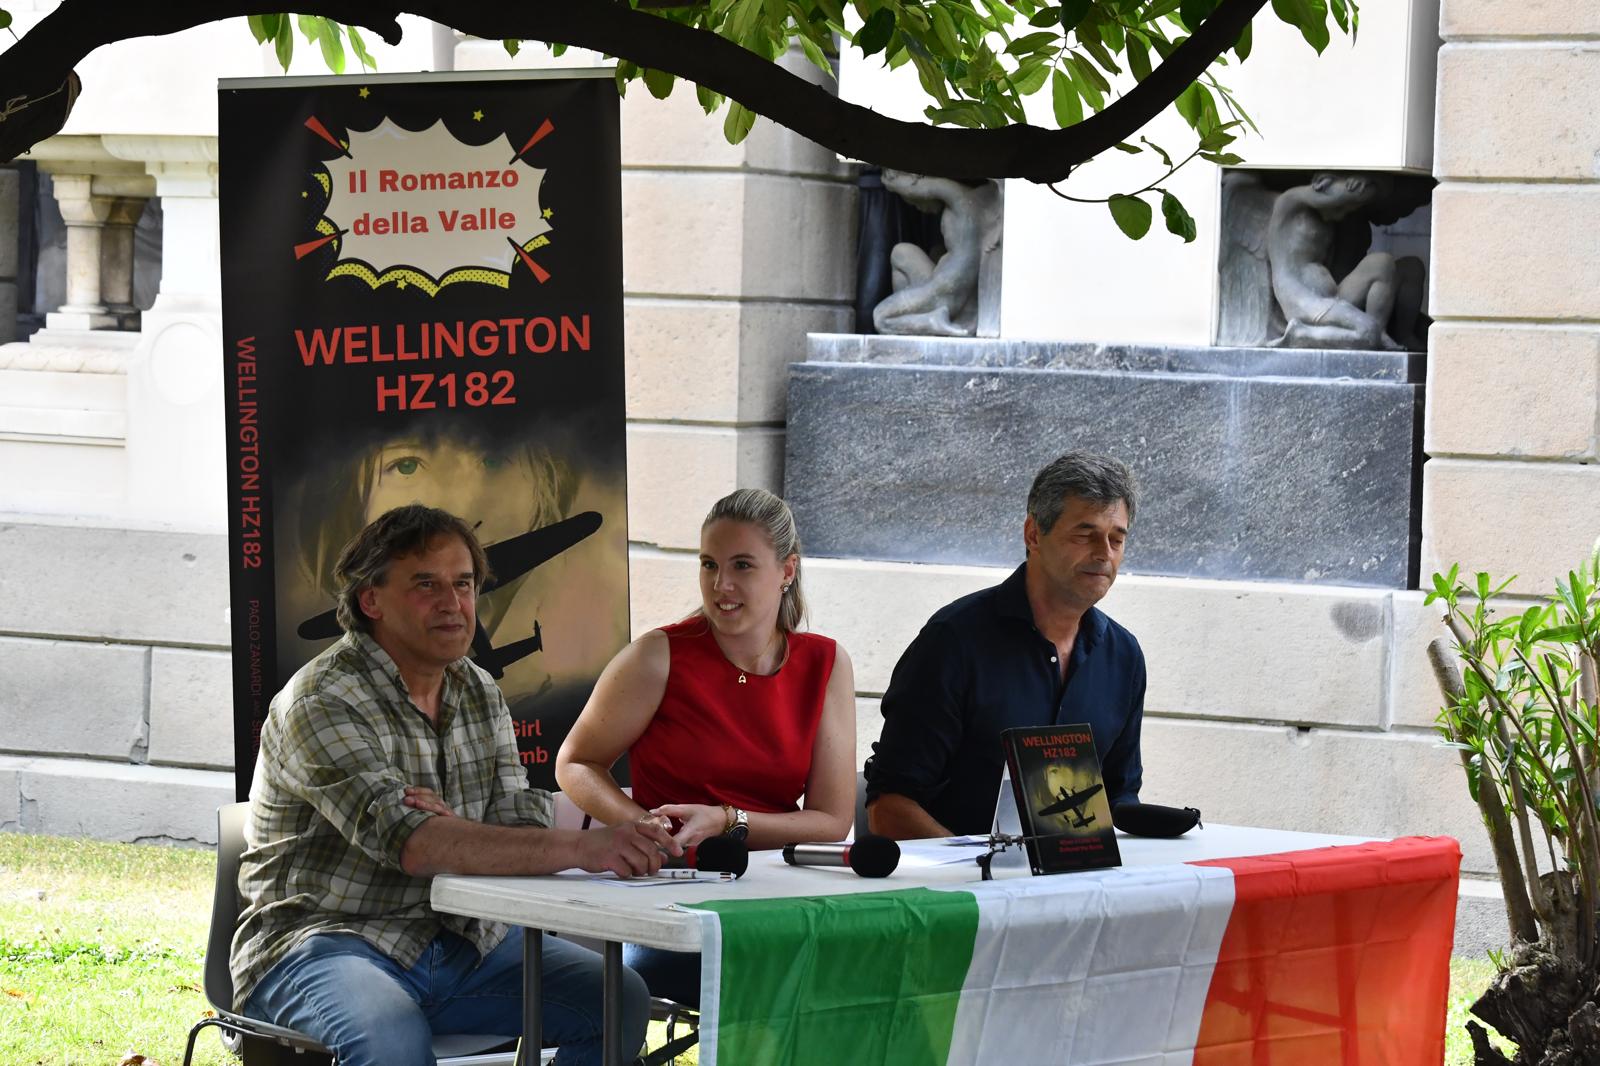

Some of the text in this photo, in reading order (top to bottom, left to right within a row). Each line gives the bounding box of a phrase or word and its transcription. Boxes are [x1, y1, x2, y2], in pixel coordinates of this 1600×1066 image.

[348, 168, 520, 193] Il Romanzo
[352, 207, 516, 236] della Valle
[294, 314, 591, 366] WELLINGTON
[376, 370, 517, 412] HZ182
[235, 336, 262, 569] WELLINGTON HZ182
[248, 599, 260, 641] PAOLO
[249, 643, 262, 696] ZANARDI
[1023, 732, 1091, 748] WELLINGTON
[1042, 747, 1077, 758] HZ182
